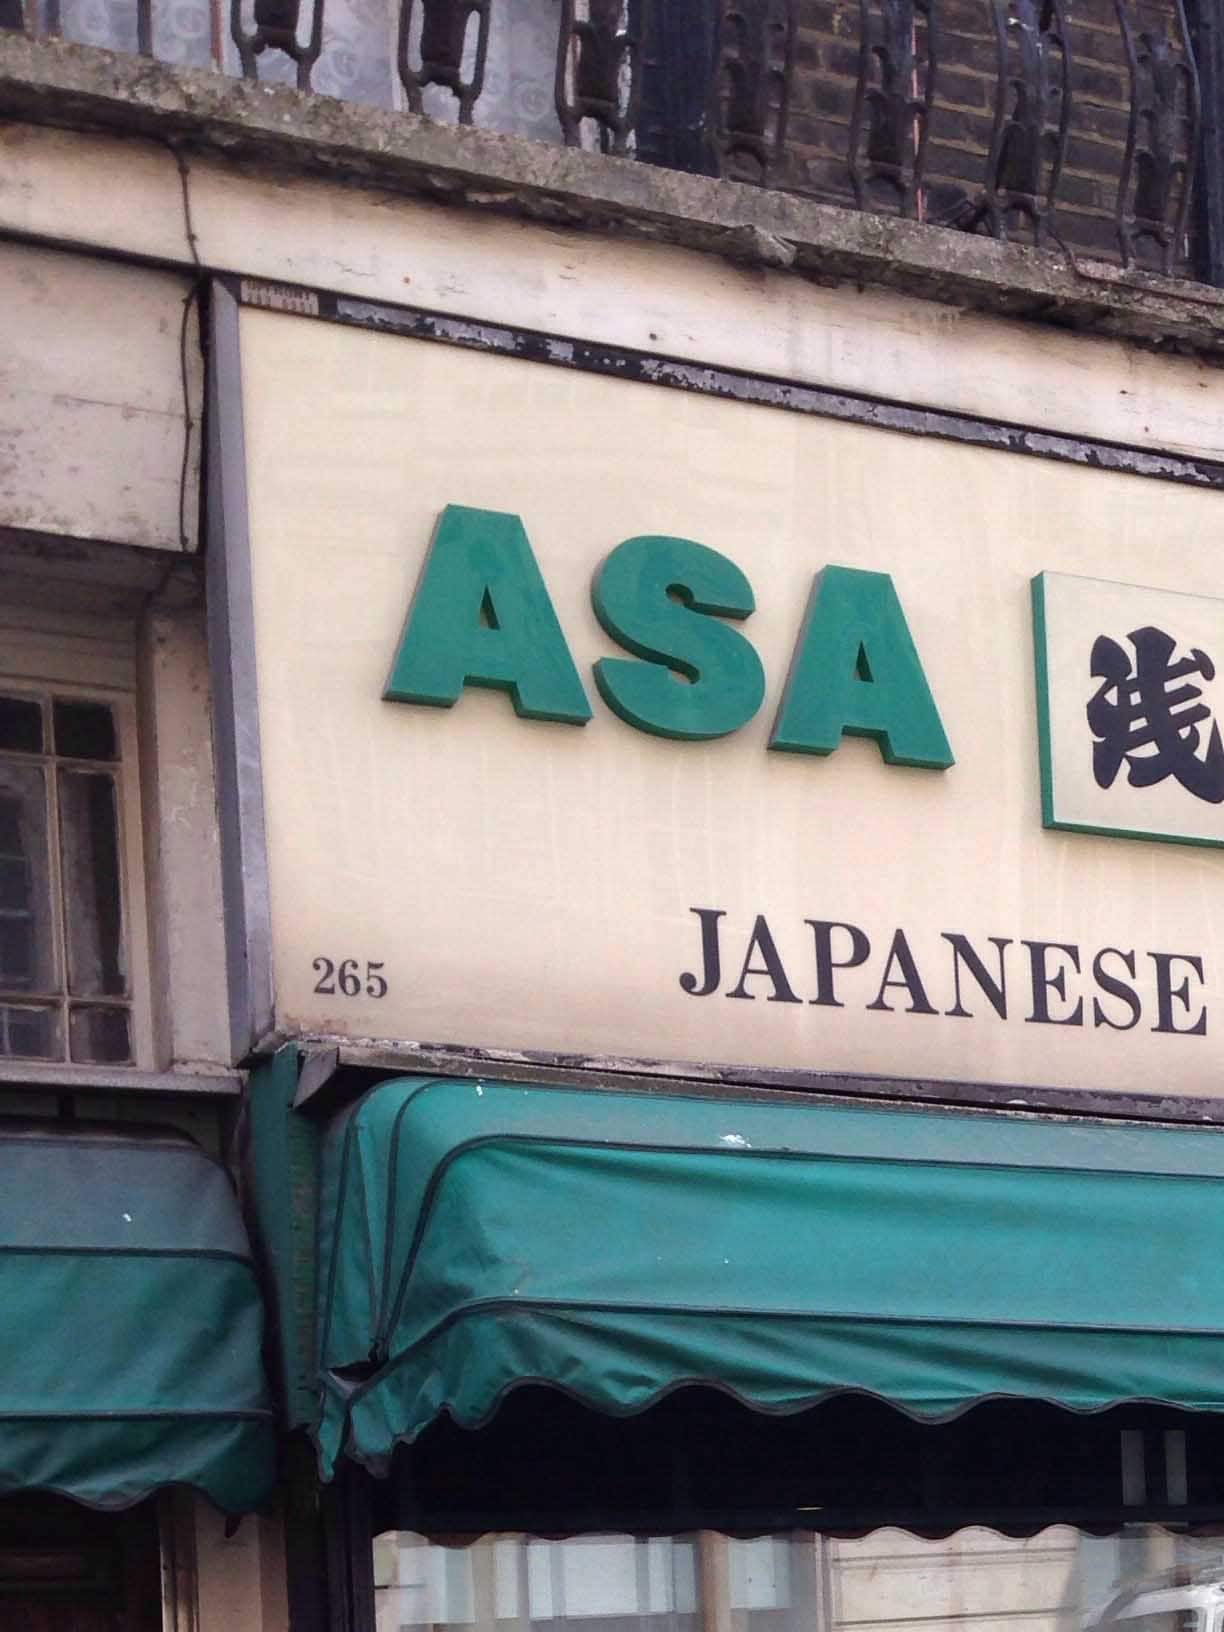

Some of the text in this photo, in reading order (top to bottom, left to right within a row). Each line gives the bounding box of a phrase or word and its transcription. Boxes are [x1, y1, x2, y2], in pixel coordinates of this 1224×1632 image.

[382, 504, 955, 773] ASA
[313, 957, 388, 998] 265
[679, 907, 1207, 1036] JAPANESE
